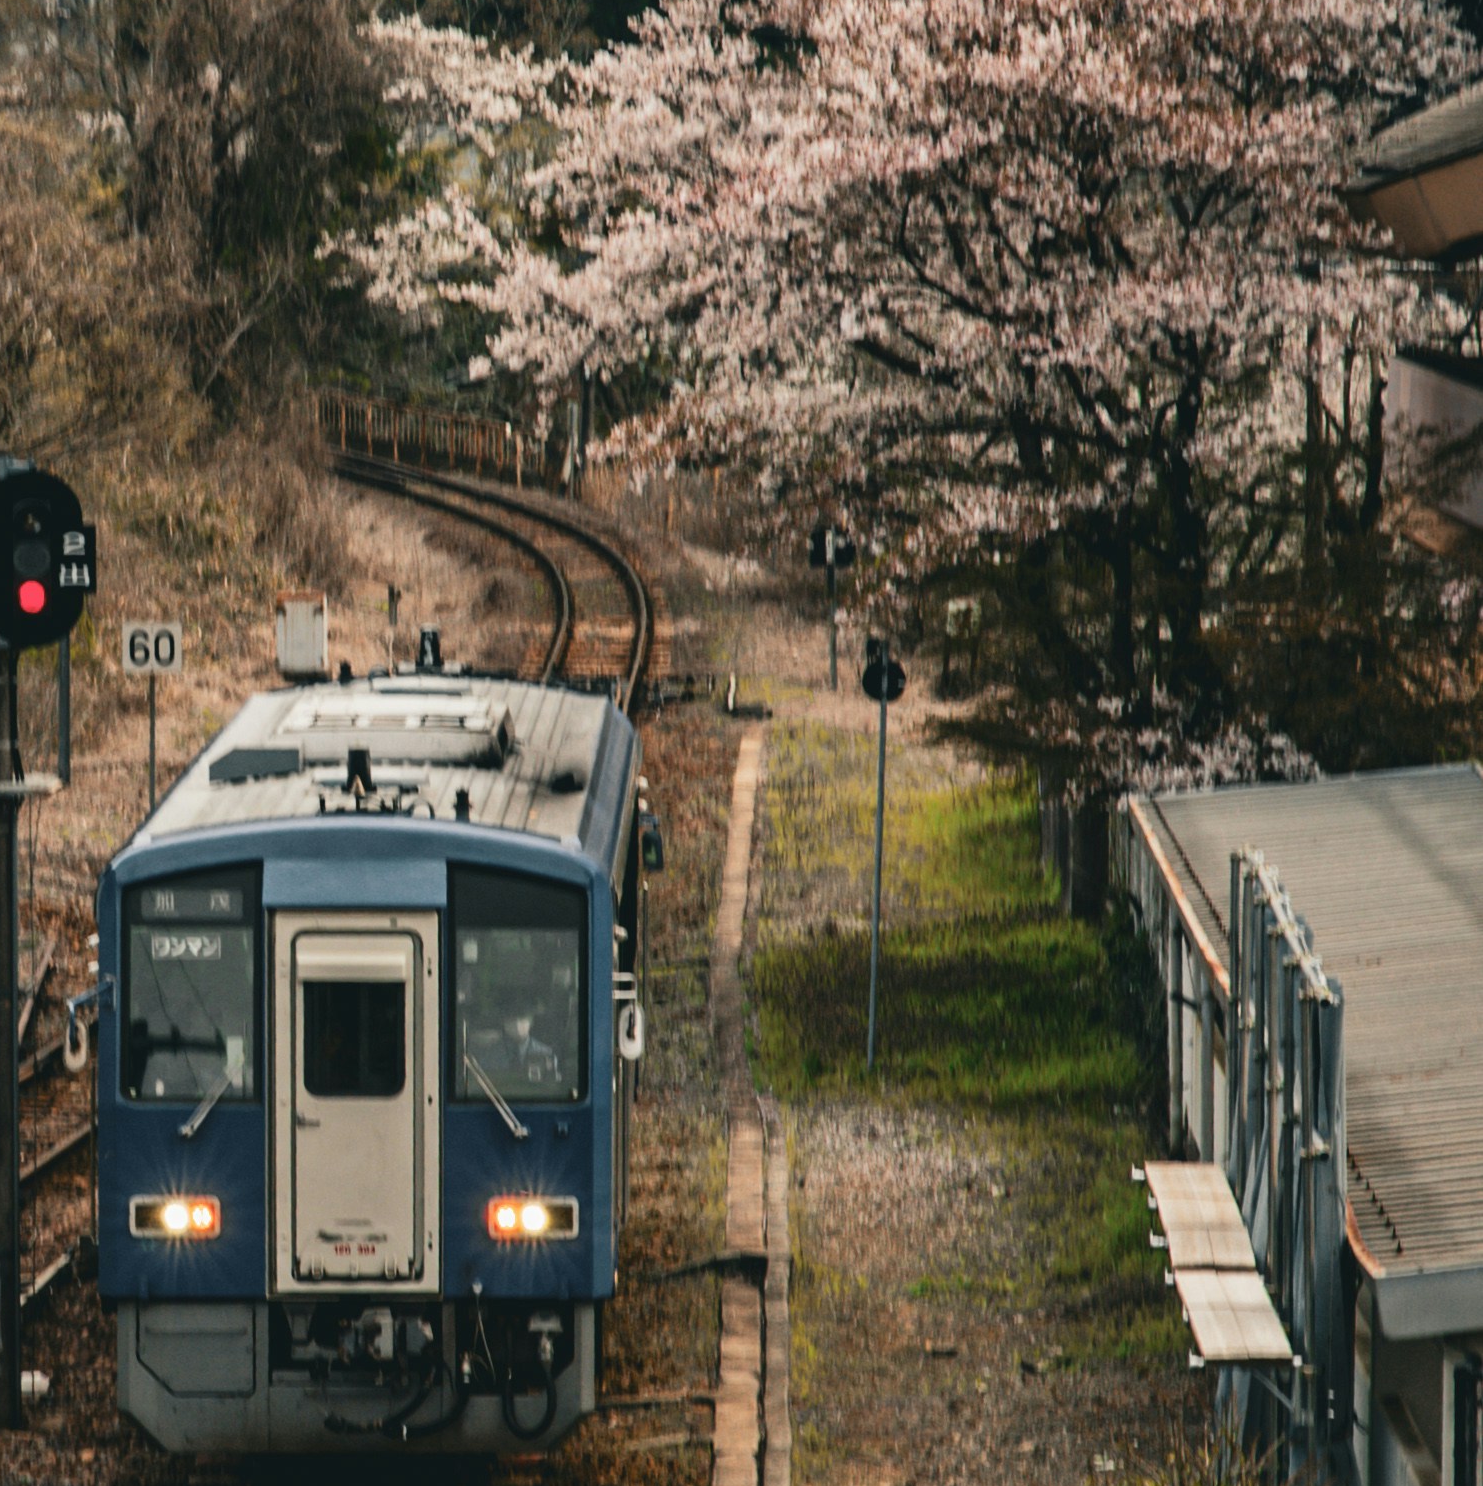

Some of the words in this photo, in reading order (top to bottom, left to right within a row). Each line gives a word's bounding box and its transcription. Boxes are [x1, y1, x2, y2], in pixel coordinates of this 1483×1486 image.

[129, 628, 175, 667] 60
[155, 935, 218, 958] ワンマン
